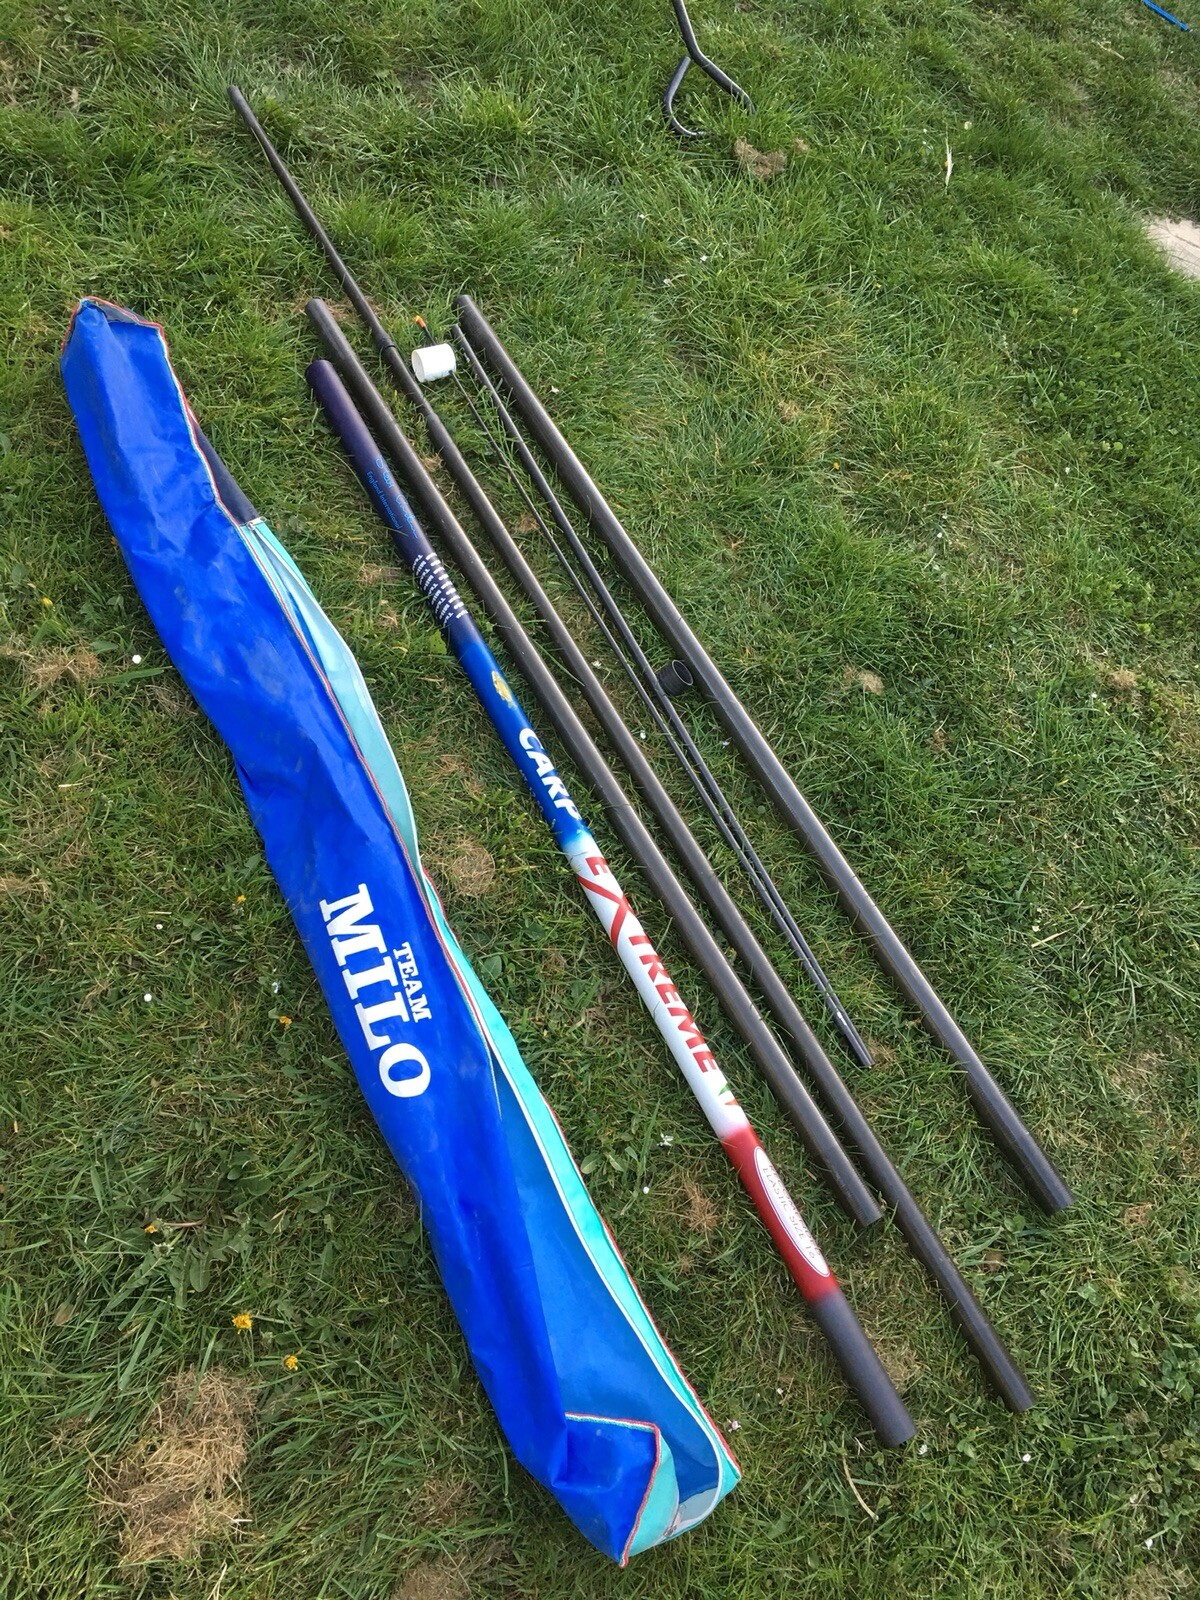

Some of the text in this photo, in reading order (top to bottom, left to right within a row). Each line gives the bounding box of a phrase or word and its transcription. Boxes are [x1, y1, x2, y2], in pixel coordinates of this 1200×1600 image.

[367, 471, 383, 494] England
[380, 494, 403, 529] International
[519, 728, 582, 821] CARP
[319, 883, 431, 1098] MILO
[393, 941, 433, 1023] TEAM
[576, 857, 718, 1072] EXTREME
[763, 1167, 790, 1212] ELASTIC
[789, 1215, 805, 1240] SIZE
